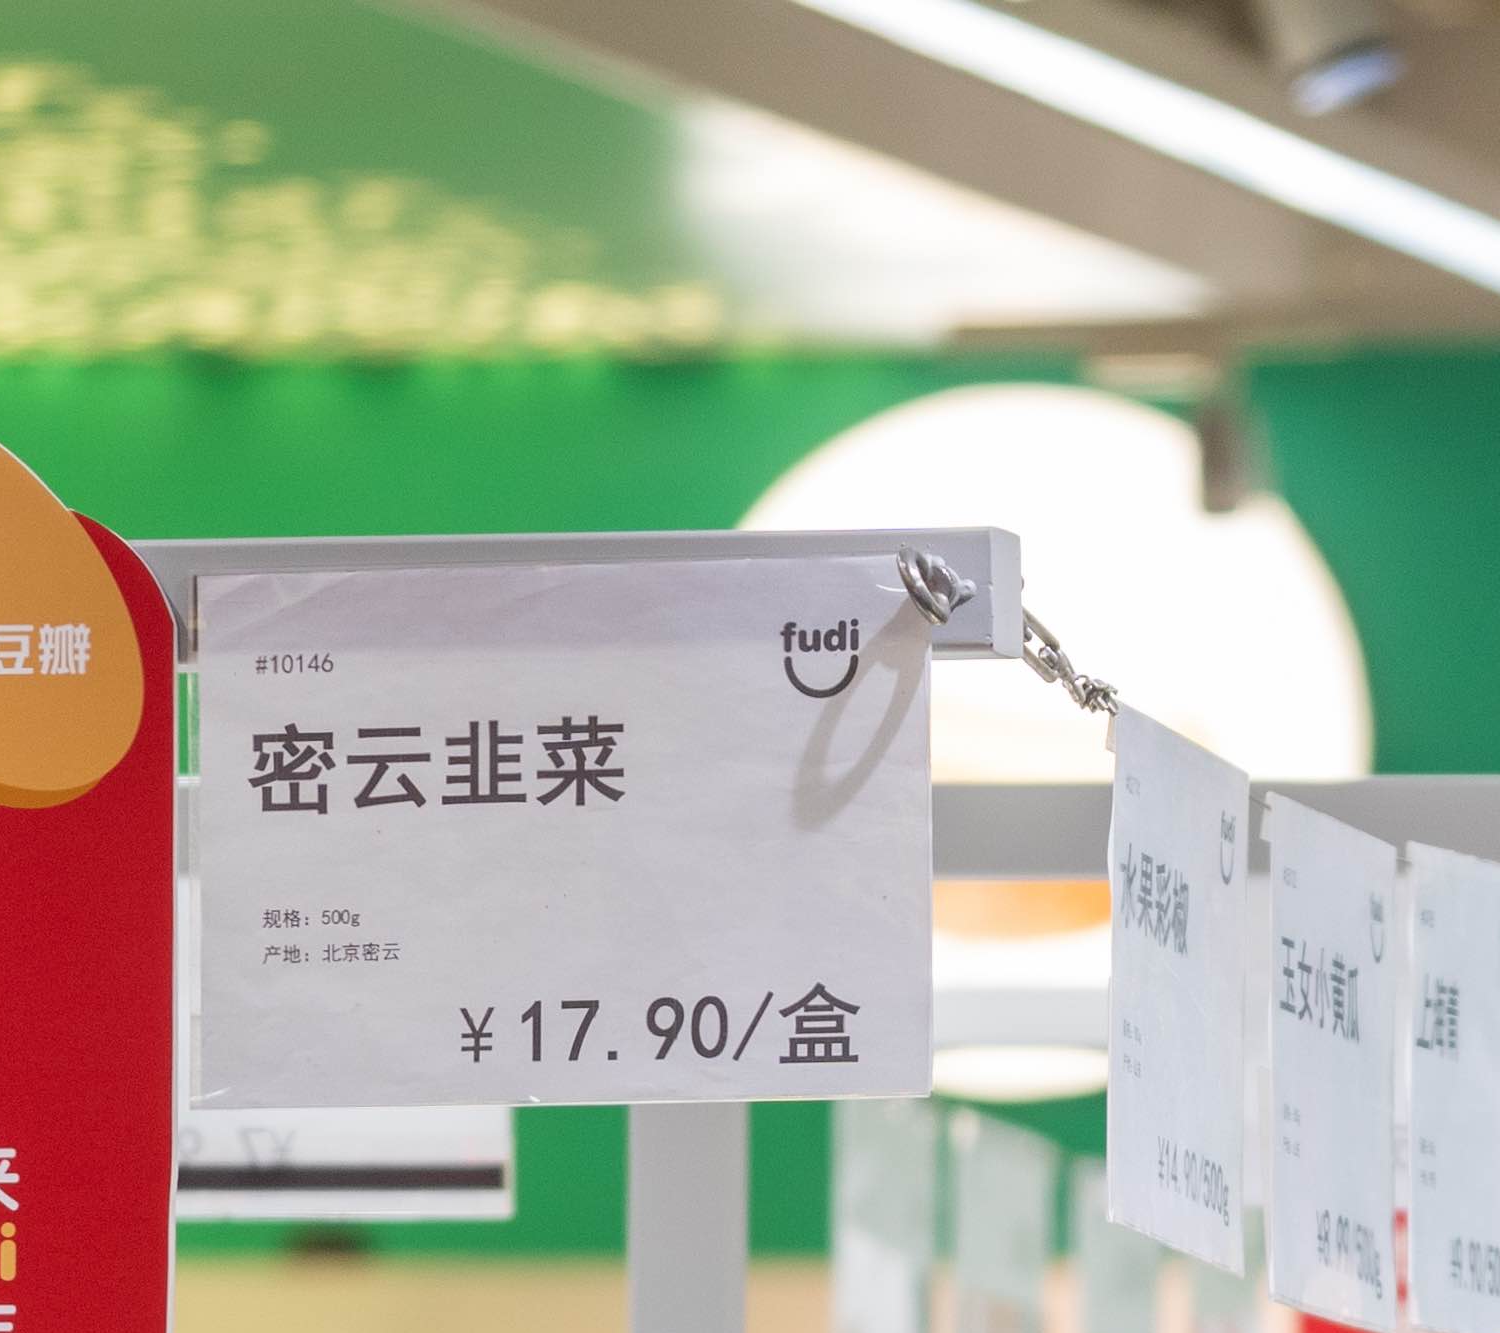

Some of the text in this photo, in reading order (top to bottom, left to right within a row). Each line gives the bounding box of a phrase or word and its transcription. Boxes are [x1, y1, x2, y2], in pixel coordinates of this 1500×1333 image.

[779, 619, 860, 653] fudi
[255, 652, 335, 674] #10146
[247, 715, 626, 815] 密云韭菜
